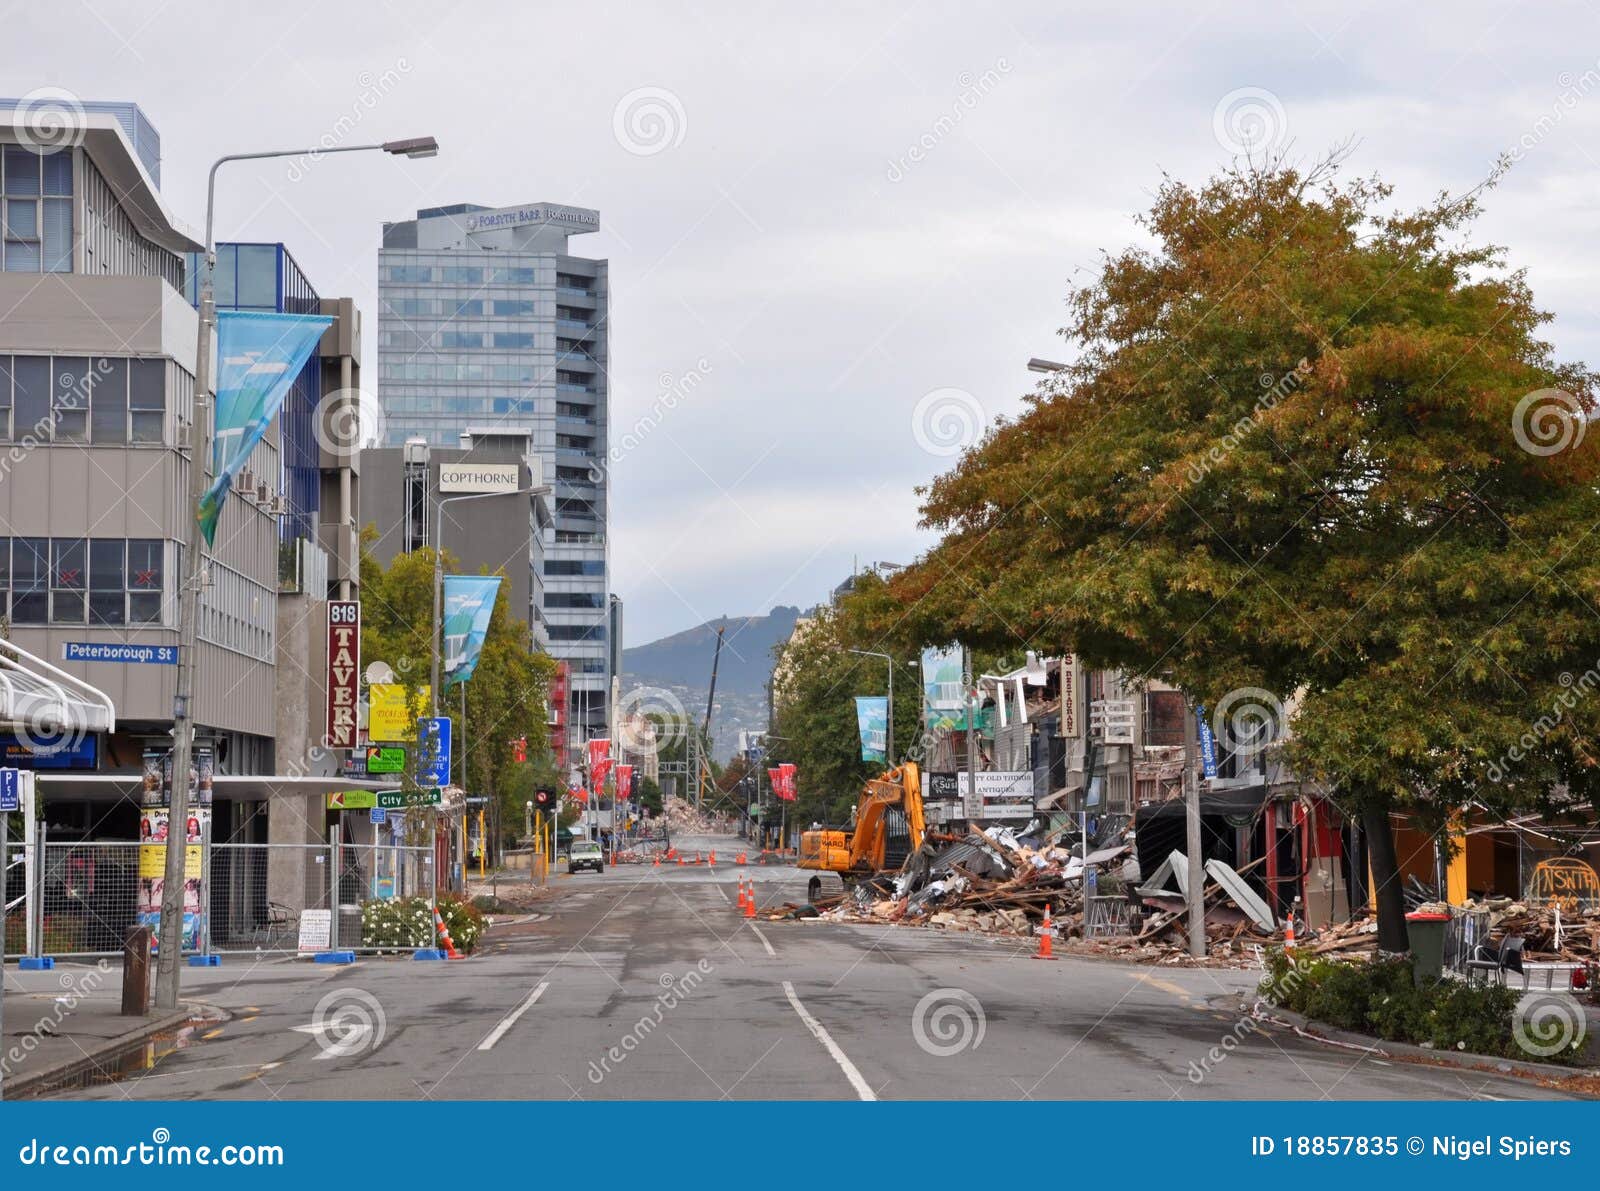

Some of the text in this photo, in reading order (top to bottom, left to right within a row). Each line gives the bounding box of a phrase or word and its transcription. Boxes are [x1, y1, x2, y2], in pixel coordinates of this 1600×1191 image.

[480, 213, 516, 227] FORSYTH
[441, 471, 517, 484] COPTHORNE
[331, 605, 356, 623] 818
[69, 644, 172, 662] Peterborough St
[333, 628, 356, 745] TAVERN
[1065, 670, 1074, 734] RESTAURANT
[5, 771, 13, 785] P
[381, 796, 402, 806] City
